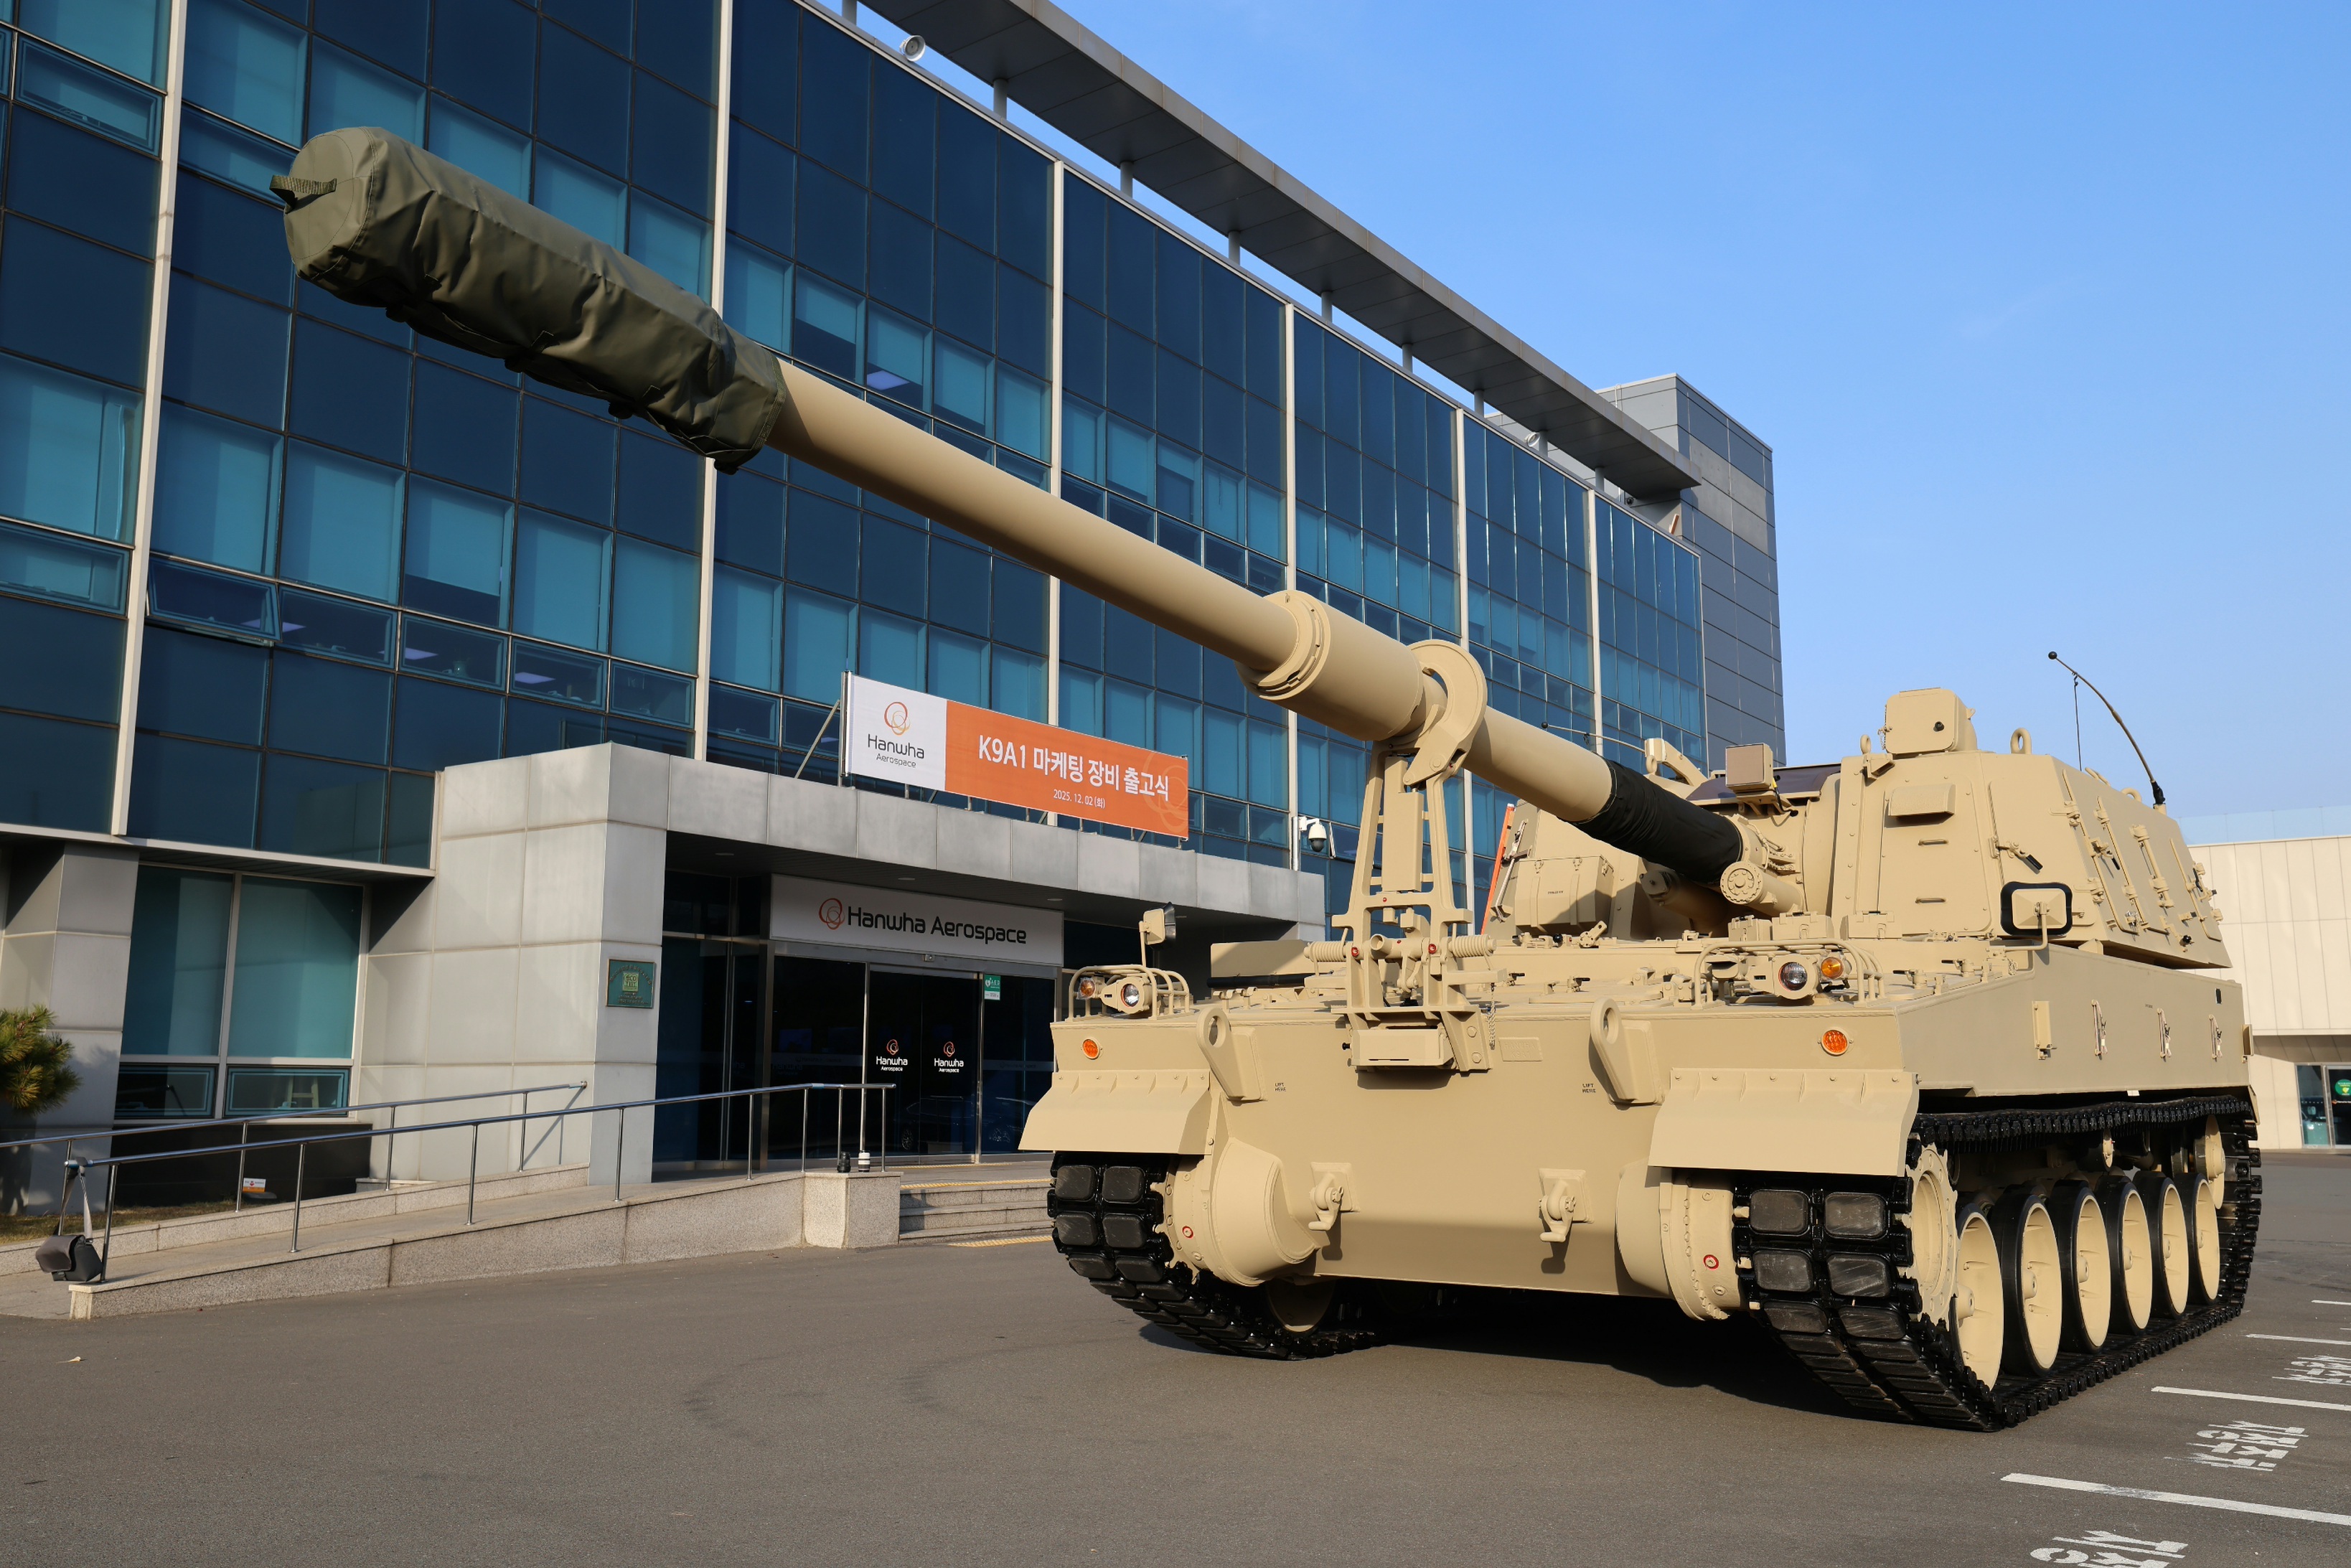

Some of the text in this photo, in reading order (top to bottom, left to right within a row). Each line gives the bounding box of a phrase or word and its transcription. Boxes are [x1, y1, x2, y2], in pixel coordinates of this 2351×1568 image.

[868, 733, 924, 759] Hanwha
[876, 753, 916, 768] Aerospace
[979, 734, 1168, 802] K9A1 마케팅 장비 출고식
[1053, 789, 1072, 802] 2025.
[848, 906, 1027, 944] Hanwha Aerospace
[876, 1056, 908, 1066] Hanwha
[934, 1058, 965, 1067] Hanwha
